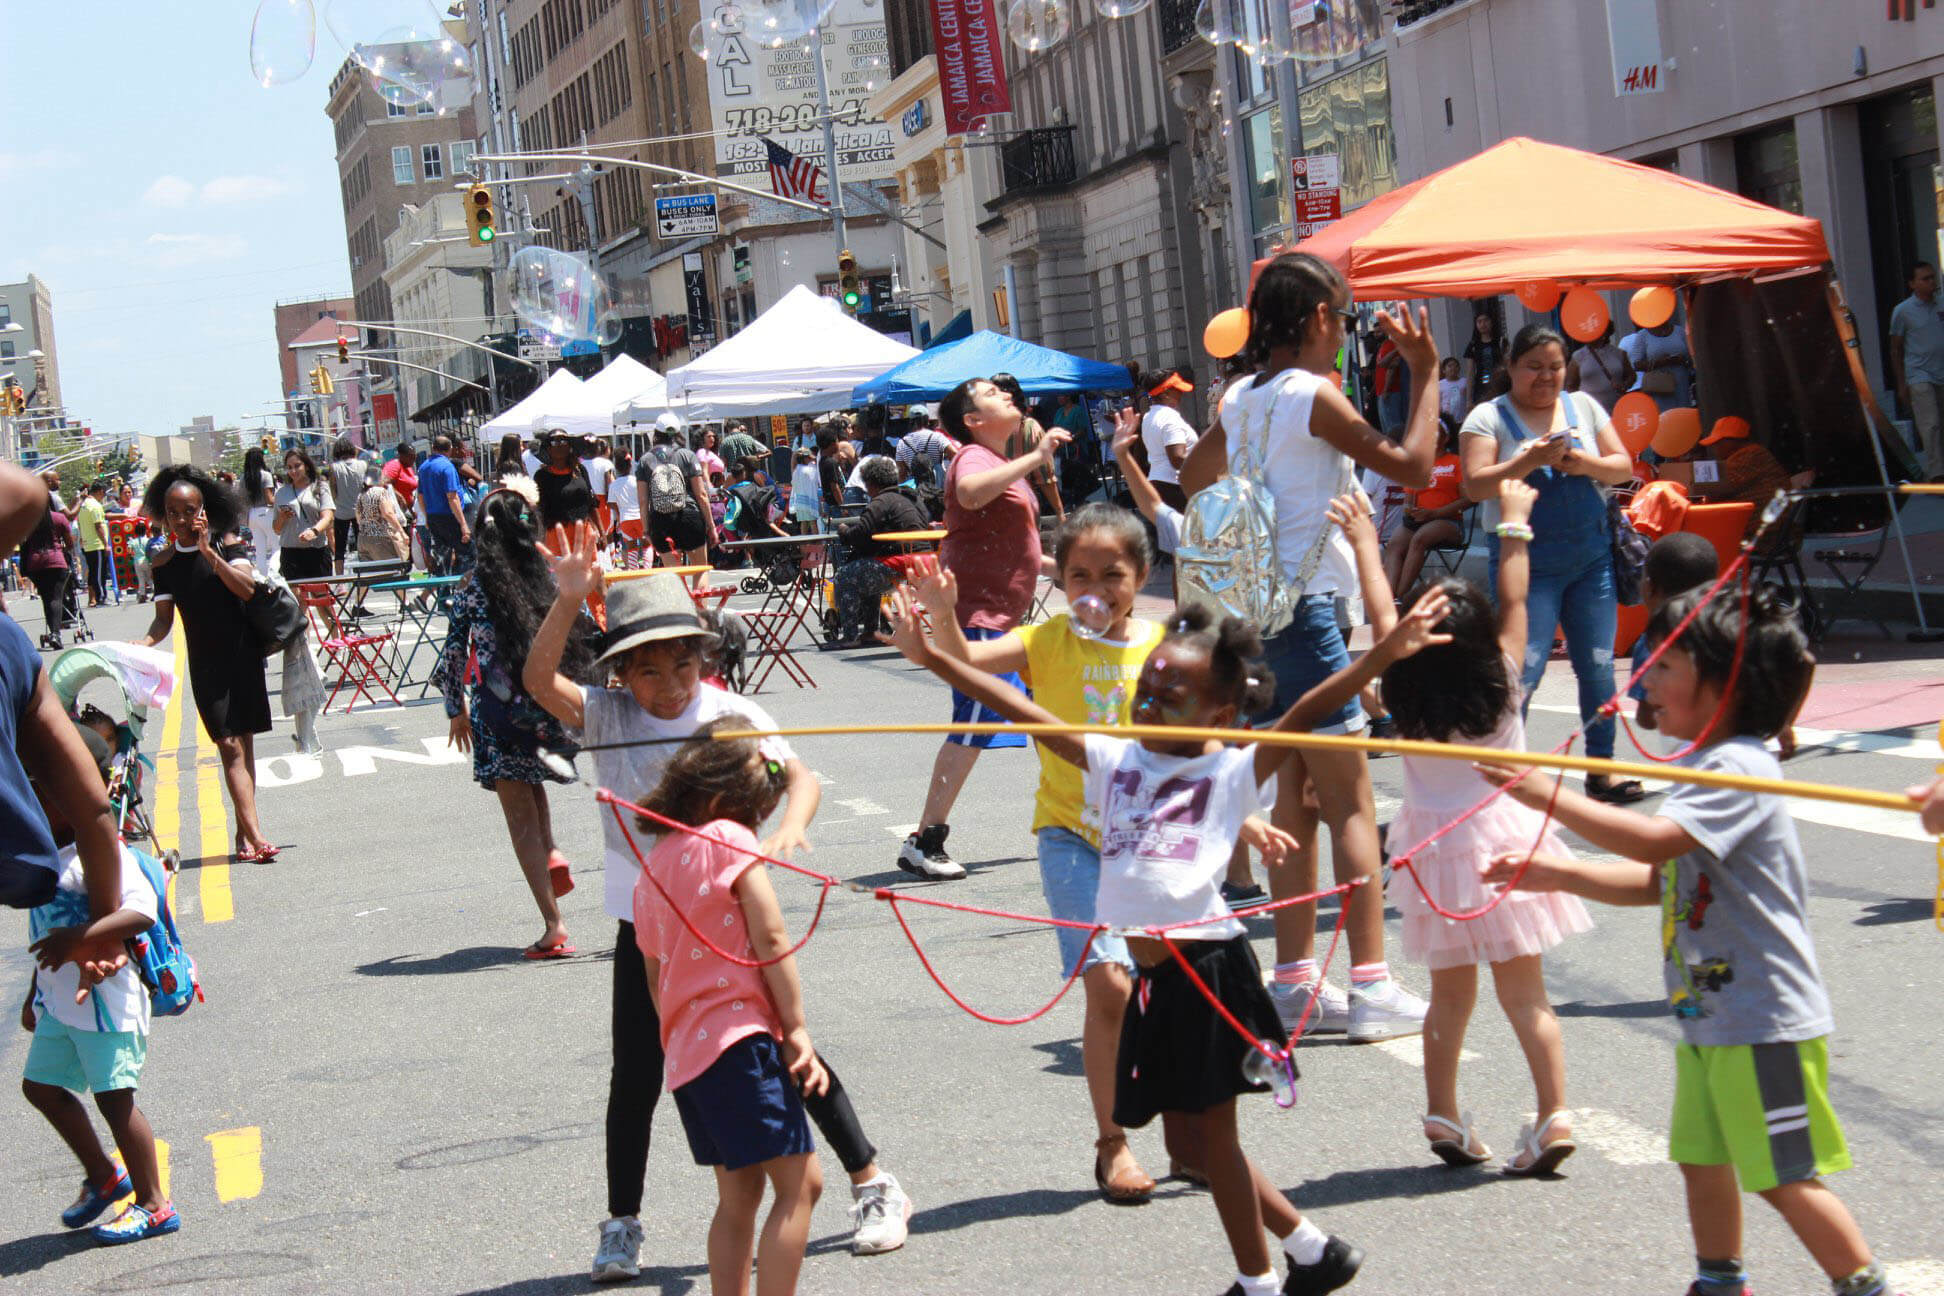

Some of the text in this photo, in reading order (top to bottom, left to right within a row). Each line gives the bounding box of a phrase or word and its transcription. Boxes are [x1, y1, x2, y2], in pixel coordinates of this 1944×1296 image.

[713, 5, 751, 97] CAL
[936, 0, 969, 104] JAMAICA CENT
[967, 17, 995, 86] JAMAICA
[775, 76, 818, 91] DERMATOLO
[802, 91, 819, 99] AND
[734, 160, 768, 174] MOST
[672, 197, 710, 207] BUS LANE
[661, 205, 711, 216] BUSES ONLY
[1297, 224, 1312, 238] NO
[687, 271, 705, 332] Nails
